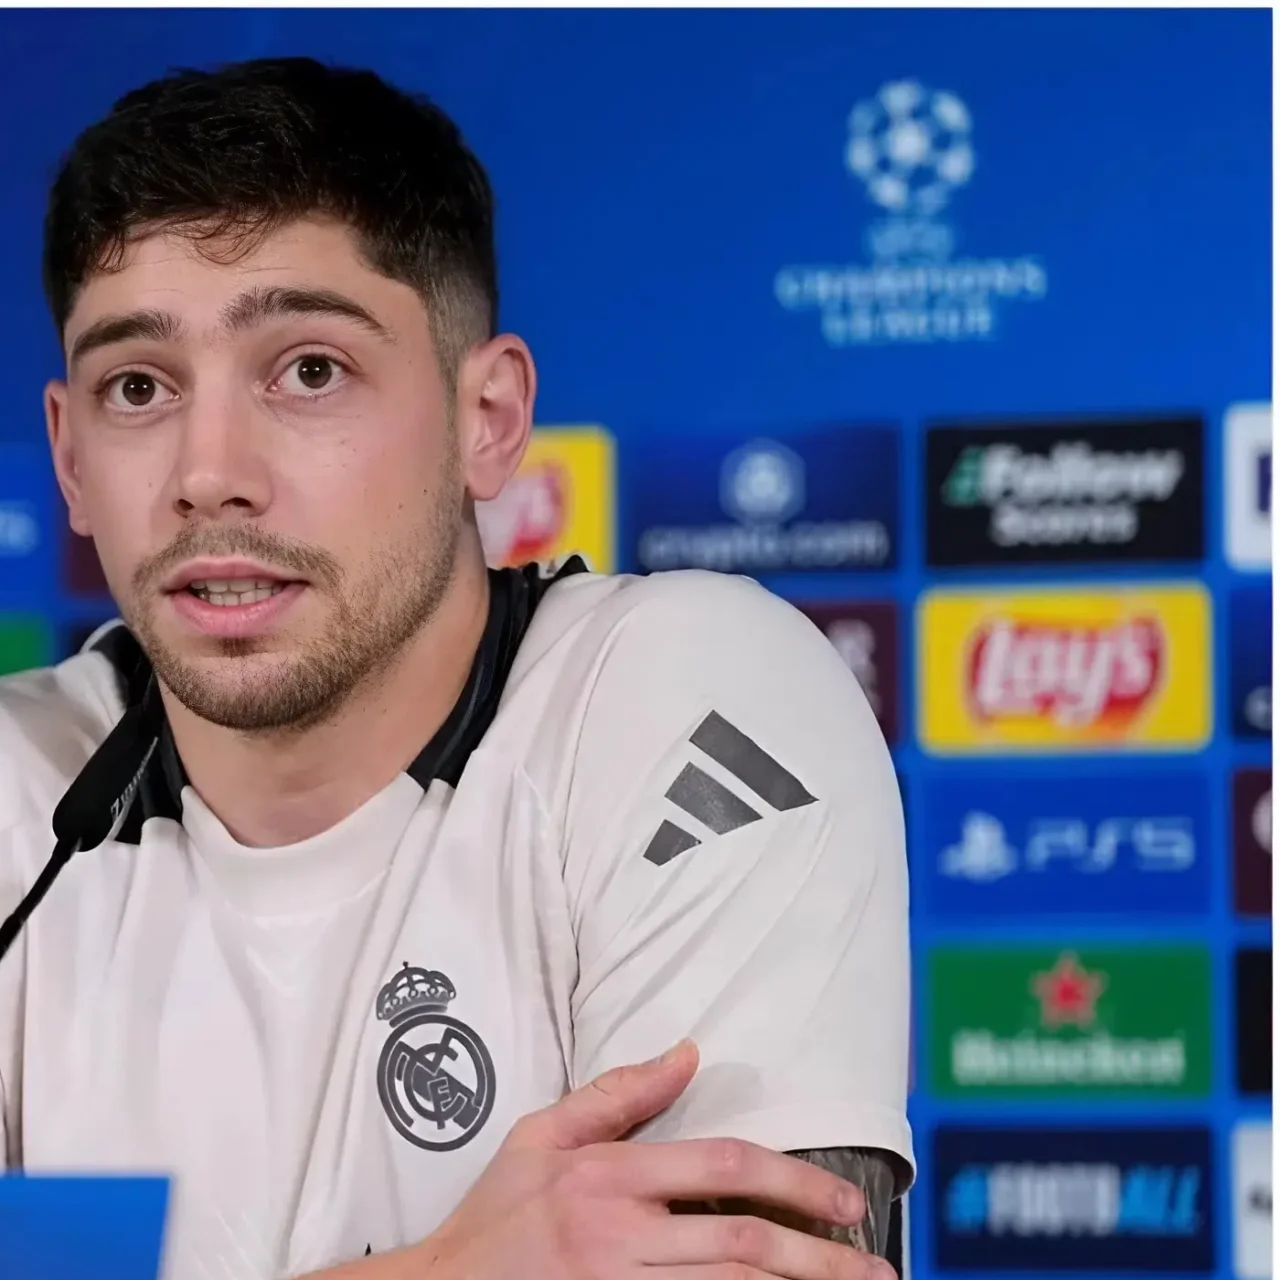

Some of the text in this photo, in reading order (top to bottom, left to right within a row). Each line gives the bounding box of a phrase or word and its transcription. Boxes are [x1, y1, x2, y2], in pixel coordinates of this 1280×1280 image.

[640, 522, 888, 570] crypto.com
[977, 618, 1154, 730] Lay's
[1026, 818, 1195, 871] PS5
[952, 1031, 1186, 1084] Heineken
